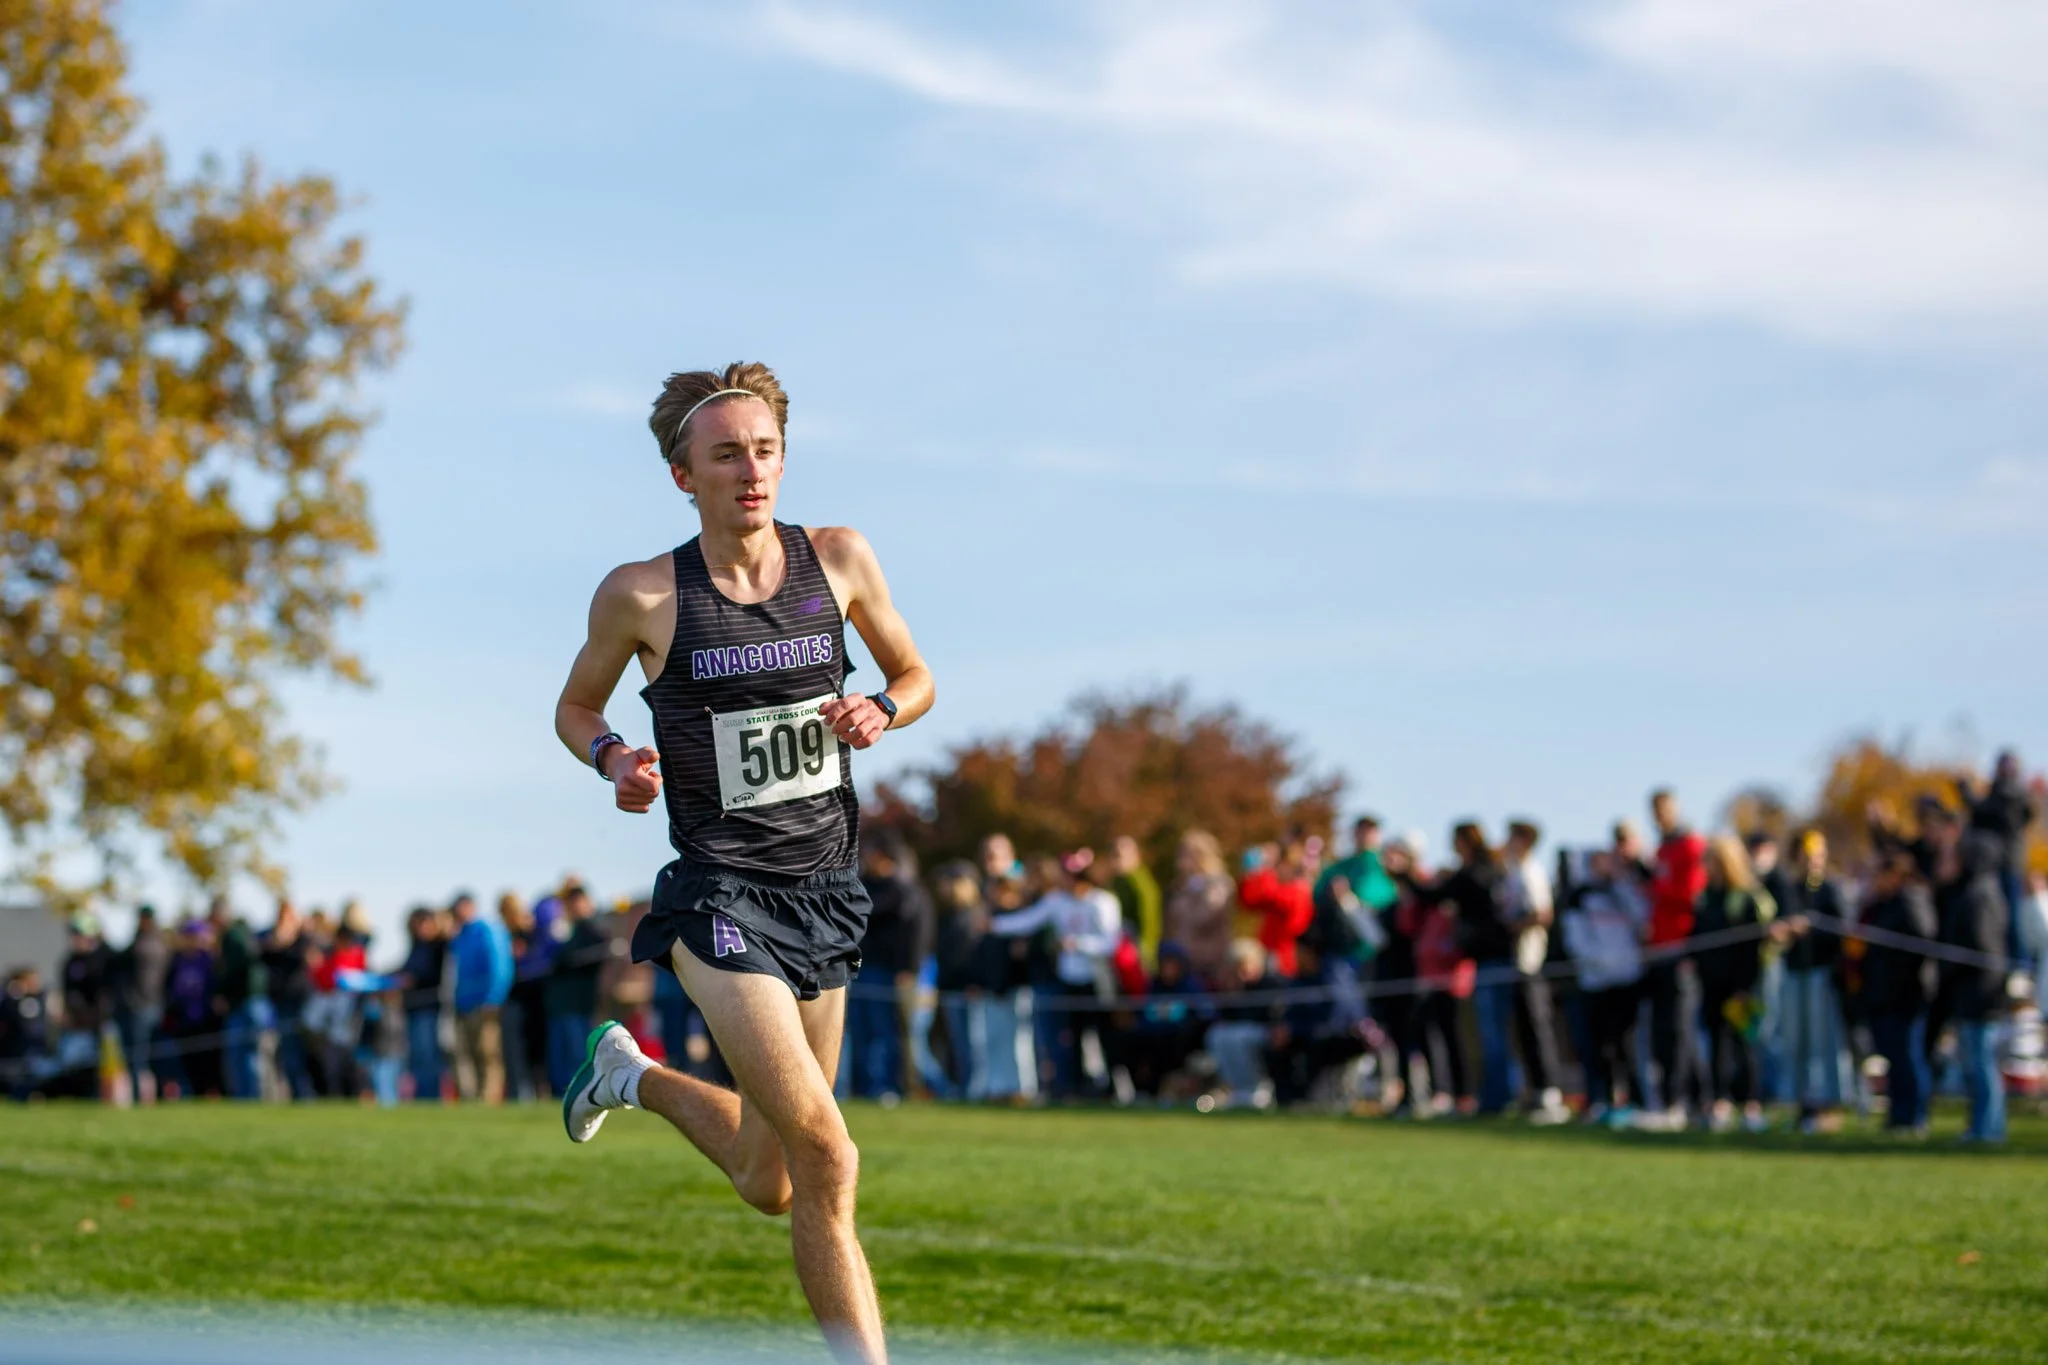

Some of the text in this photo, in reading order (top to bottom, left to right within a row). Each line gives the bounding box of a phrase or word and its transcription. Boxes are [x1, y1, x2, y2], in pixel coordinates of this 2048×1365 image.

[692, 633, 832, 680] ANACORTES
[746, 714, 771, 725] STATE
[773, 710, 799, 721] CROSS
[800, 706, 820, 717] COUN
[739, 719, 825, 787] 509
[712, 914, 747, 958] A
